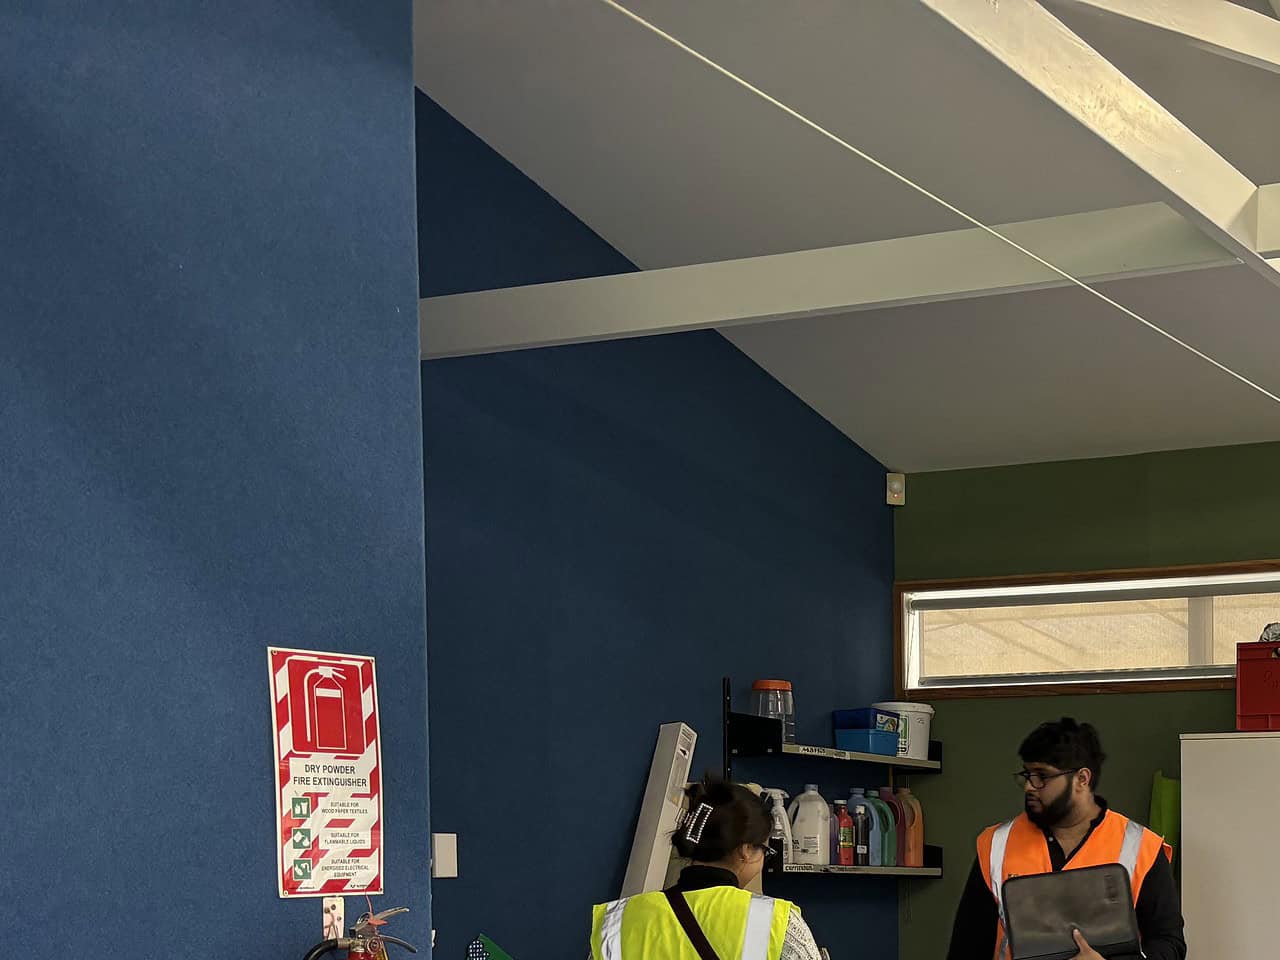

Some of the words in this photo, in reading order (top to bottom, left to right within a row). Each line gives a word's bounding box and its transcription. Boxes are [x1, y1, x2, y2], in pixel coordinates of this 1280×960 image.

[304, 764, 320, 774] DRY
[322, 765, 356, 775] POWDER
[293, 776, 311, 786] FIRE
[313, 776, 367, 787] EXTINGUISHER
